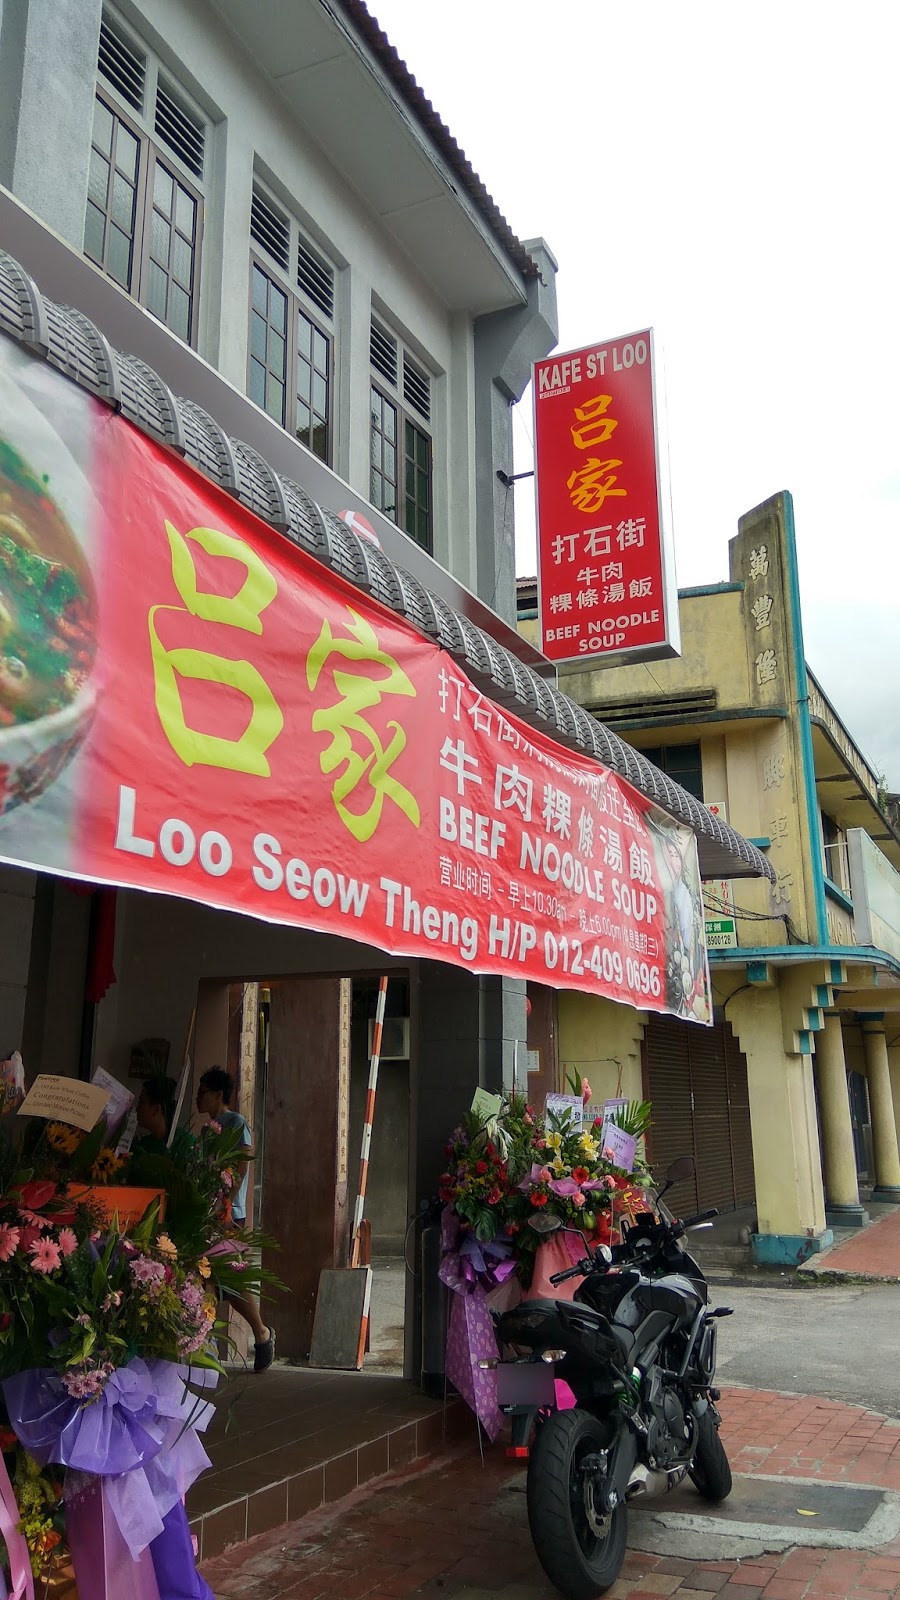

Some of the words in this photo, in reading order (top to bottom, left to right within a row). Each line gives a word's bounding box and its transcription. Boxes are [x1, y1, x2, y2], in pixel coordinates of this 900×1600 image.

[539, 358, 582, 392] KAFE
[586, 352, 607, 380] ST
[613, 339, 648, 372] LOO
[551, 516, 648, 566] 打石街
[576, 561, 624, 587] 牛肉
[546, 623, 581, 643] BEEF
[588, 609, 660, 634] NOODLE
[578, 632, 626, 652] SOUP
[439, 796, 507, 861] BEEF
[519, 831, 605, 904] NOODLE
[612, 880, 658, 924] SOUP
[439, 855, 493, 901] 营业时间
[114, 784, 233, 877] Loo
[251, 832, 370, 918] Seow
[380, 879, 478, 962] Theng
[488, 912, 537, 962] H/P
[544, 931, 624, 985] 012-409
[626, 960, 661, 998] 0696
[33, 1091, 90, 1110] Congratulations
